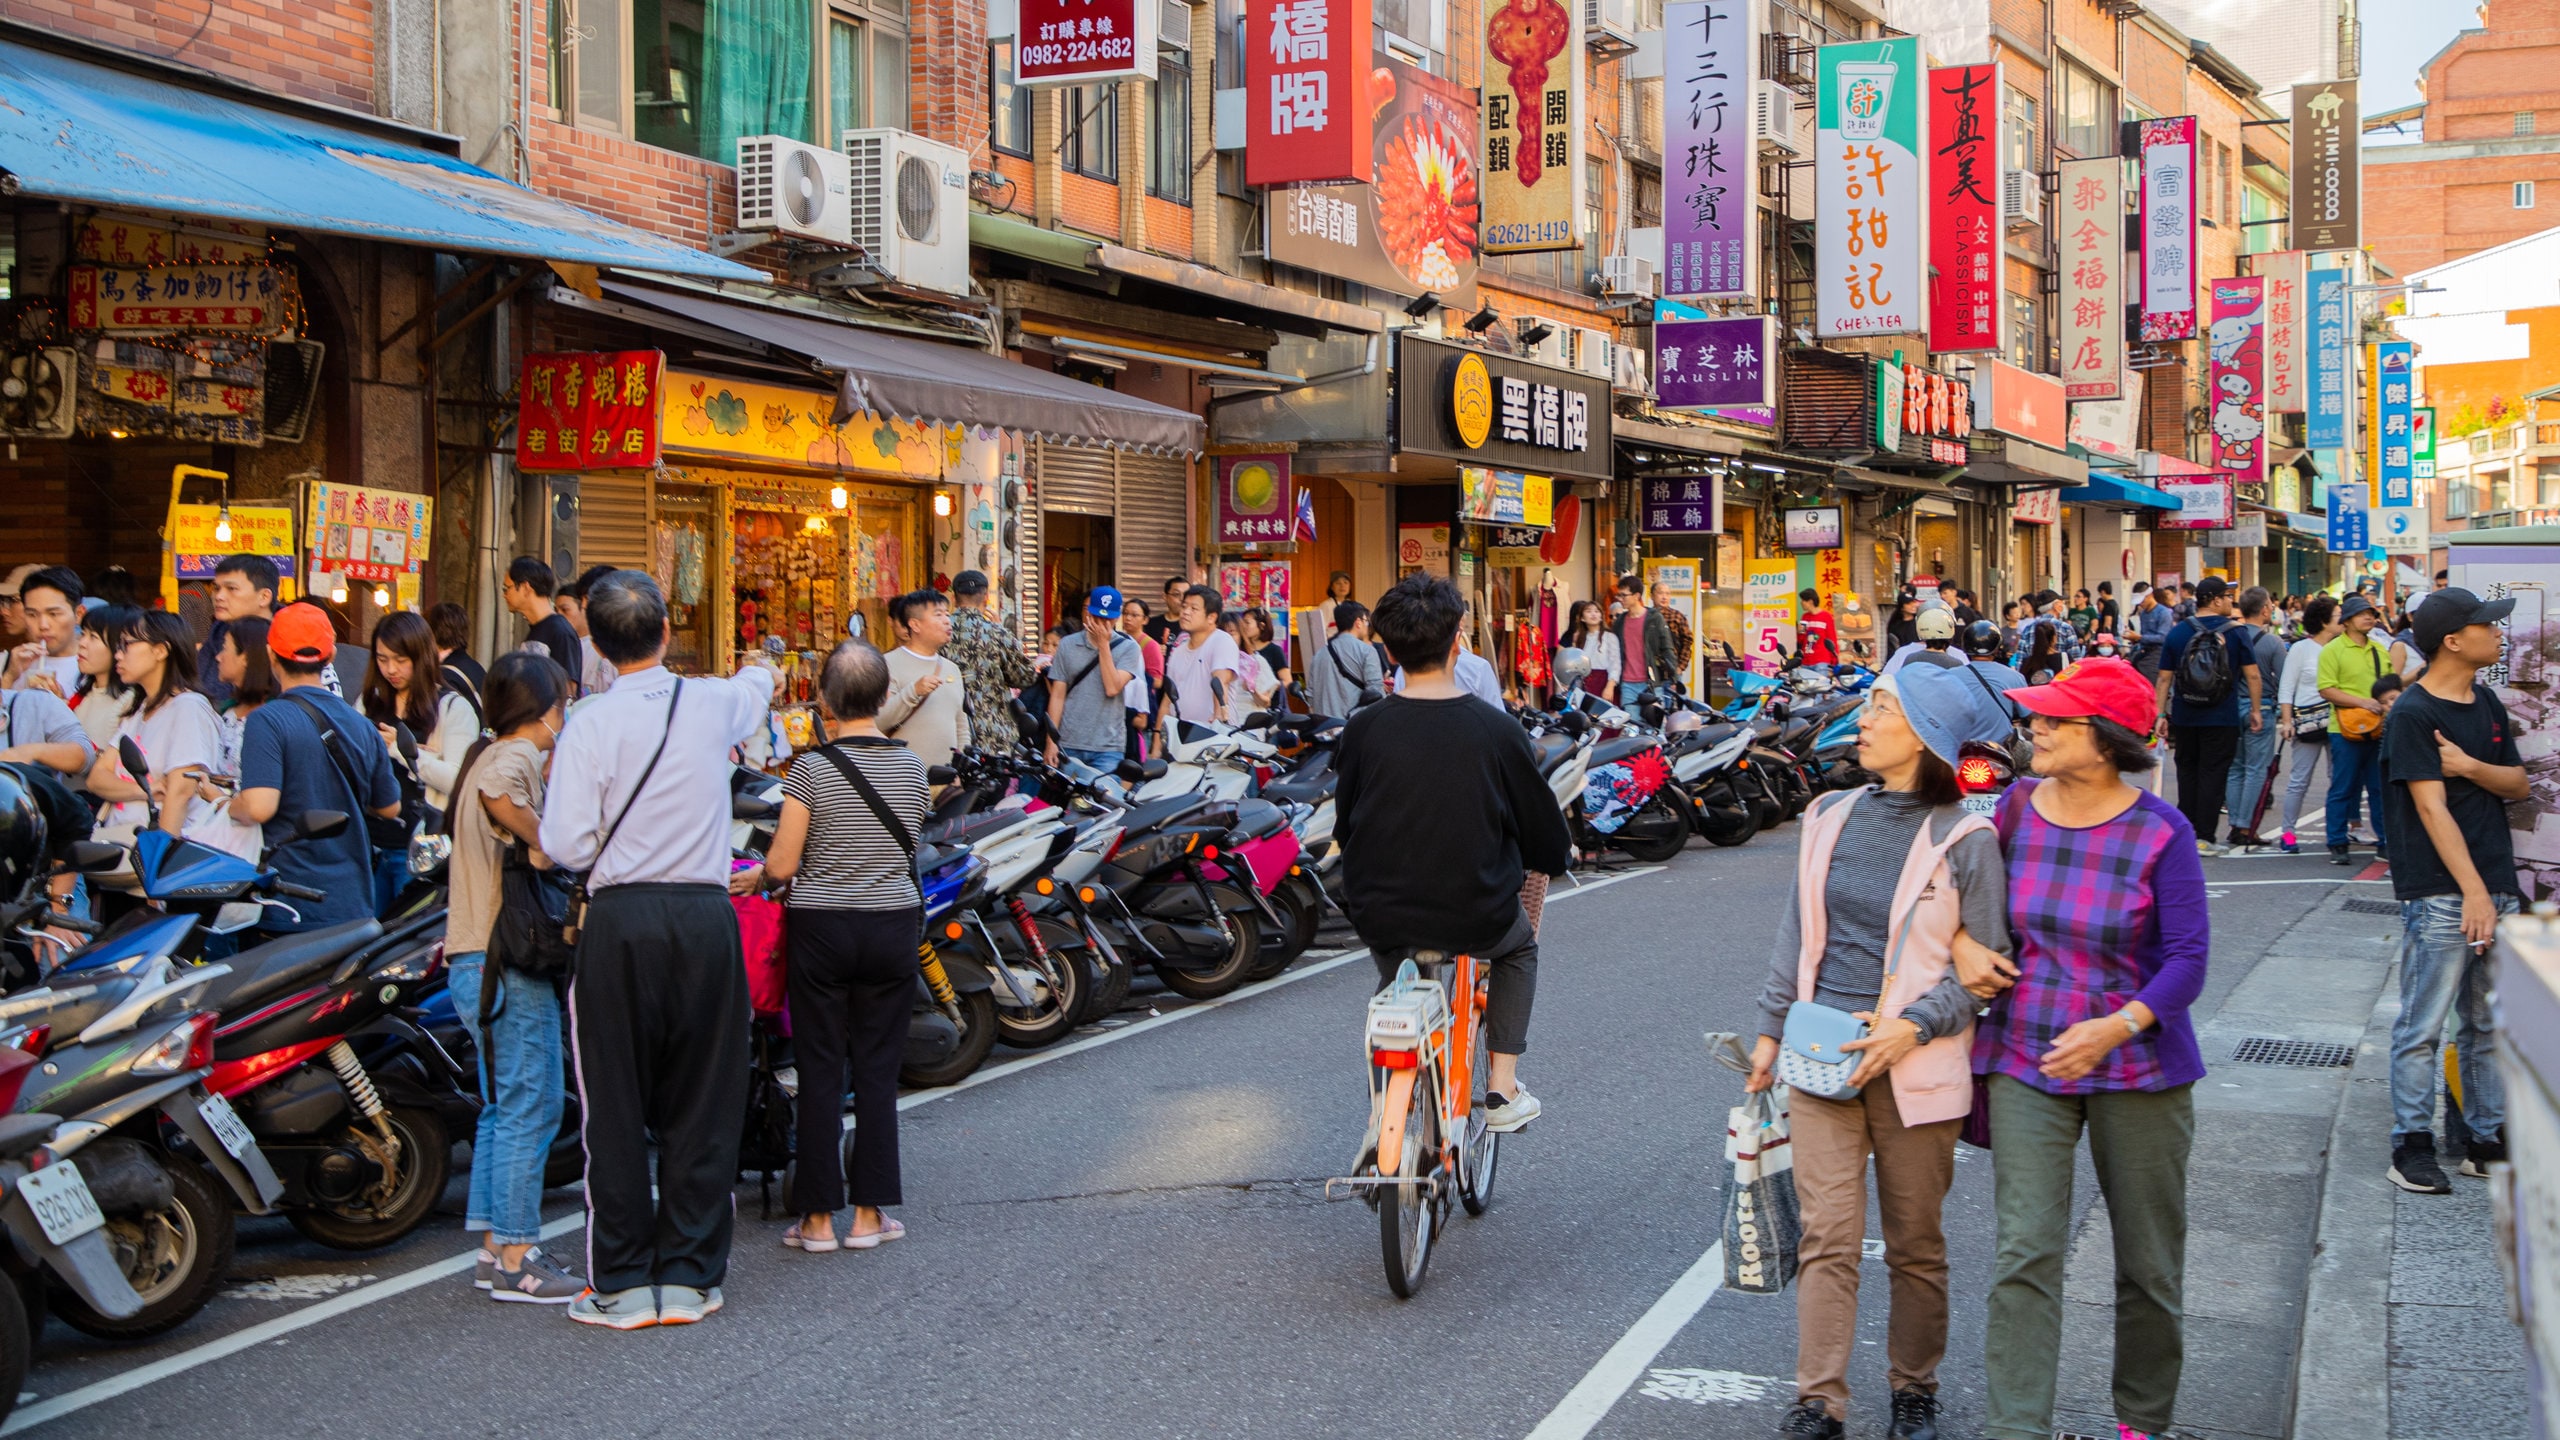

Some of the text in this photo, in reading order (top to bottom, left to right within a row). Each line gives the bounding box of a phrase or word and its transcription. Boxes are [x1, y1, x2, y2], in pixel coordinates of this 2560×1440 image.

[1039, 15, 1114, 41] 訂購專線
[1488, 94, 1510, 172] 配鎖
[1545, 90, 1567, 168] 開鎖
[1685, 5, 1729, 233] 十三行珠寶
[1298, 188, 1358, 247] 台灣香腸
[1842, 144, 1893, 309] 許甜記
[2152, 164, 2185, 276] 富發牌
[72, 270, 93, 325] 阿香
[1956, 215, 1969, 336] CLASSICISM
[2071, 176, 2111, 372] 郭全福餅店
[1661, 343, 1759, 372] 寶芝林
[2270, 279, 2295, 396] 新疆烤包子
[2318, 281, 2342, 416] 經典肉鬆蛋捲
[529, 361, 651, 410] 阿香蝦捲
[1663, 371, 1758, 384] BAUSLIN
[526, 427, 646, 455] 老街分店
[1502, 376, 1588, 452] 黑橋牌
[2385, 383, 2408, 499] 傑昇通信
[1651, 479, 1703, 501] 棉麻
[1651, 509, 1703, 529] 服飾
[1750, 574, 1786, 586] 2019
[1758, 628, 1778, 653] 5
